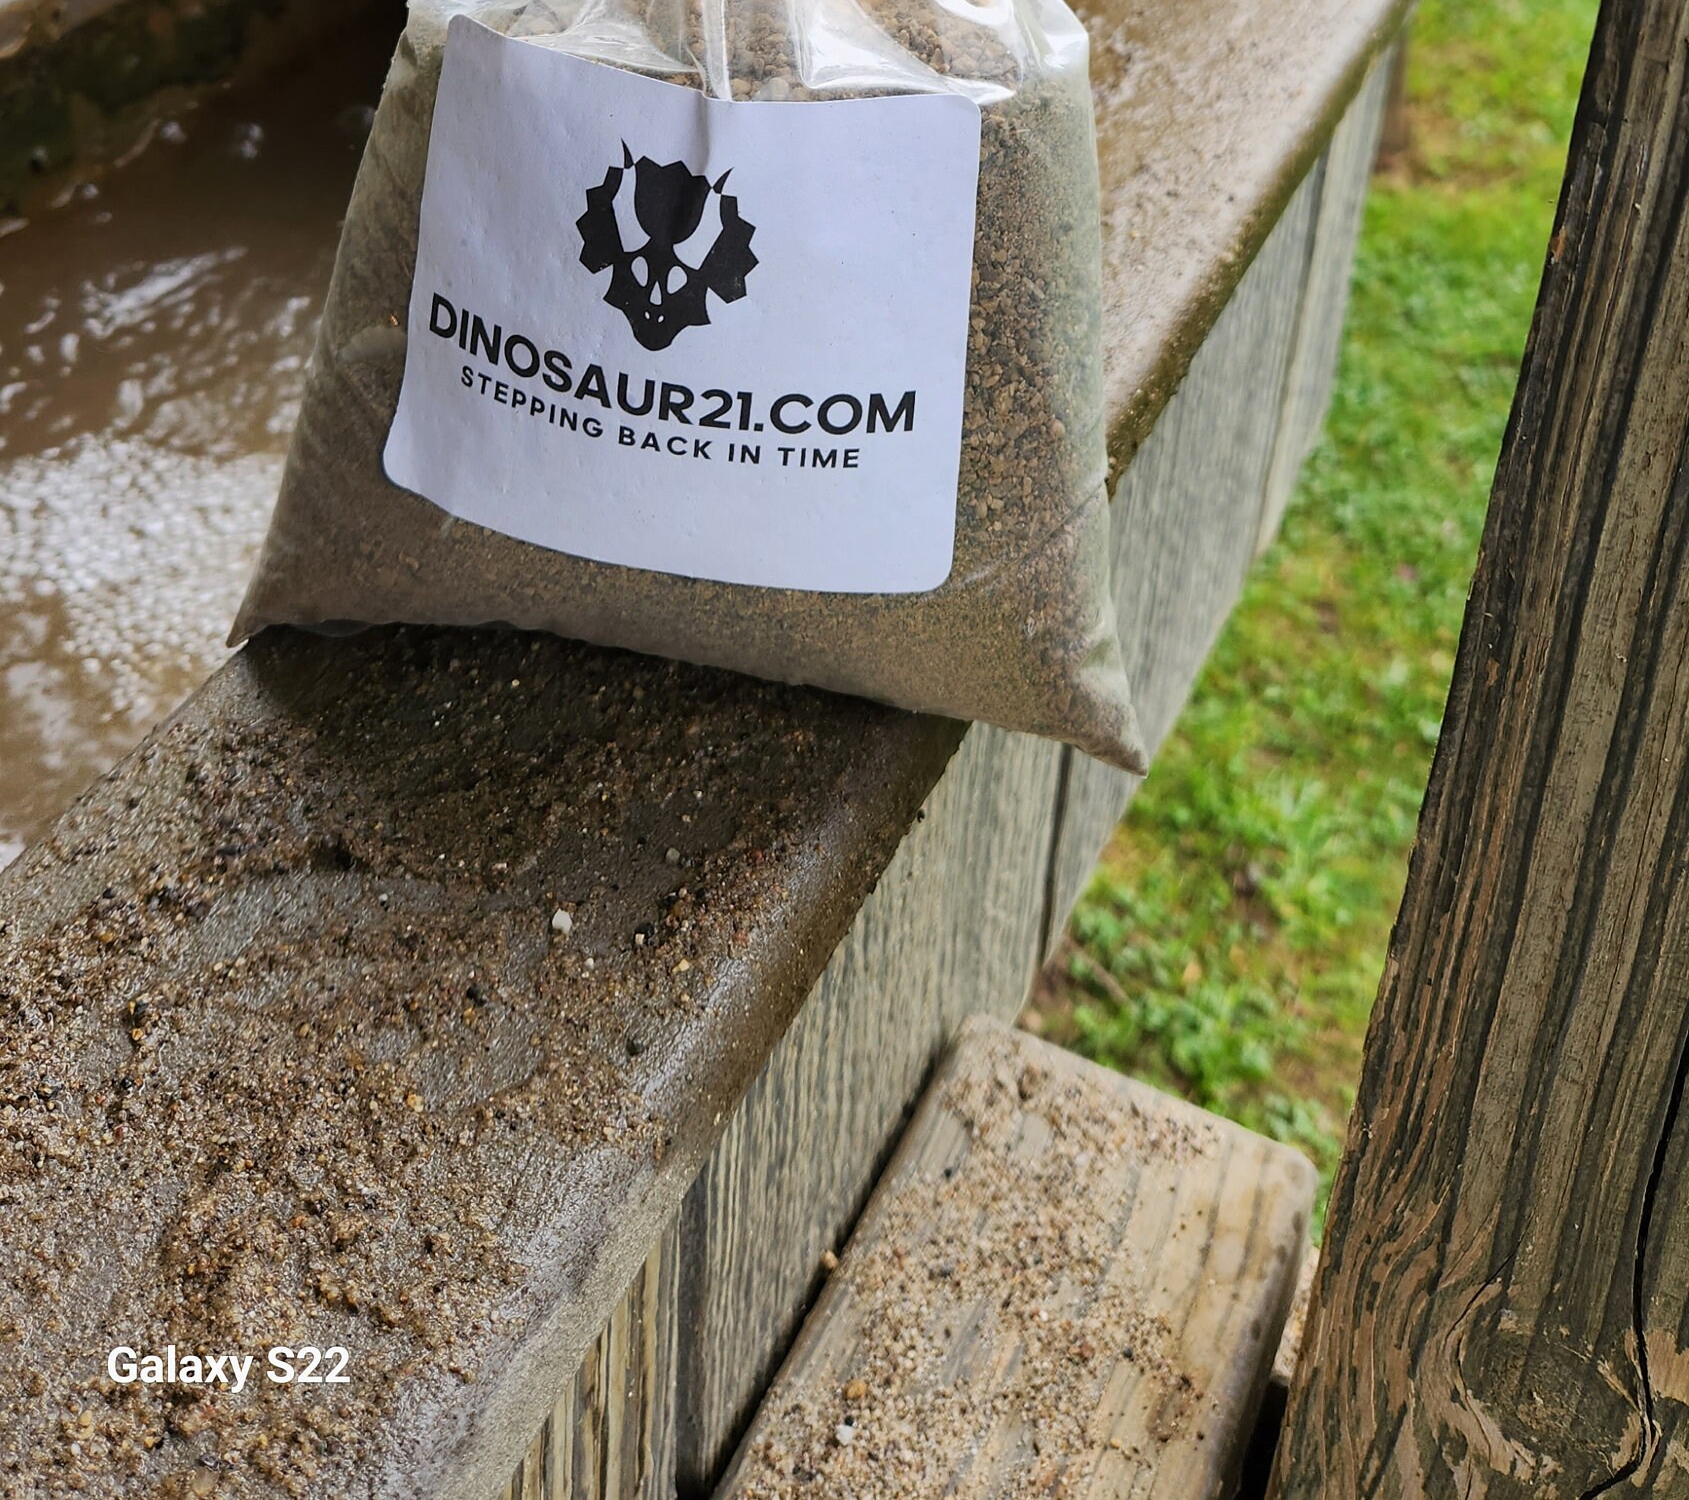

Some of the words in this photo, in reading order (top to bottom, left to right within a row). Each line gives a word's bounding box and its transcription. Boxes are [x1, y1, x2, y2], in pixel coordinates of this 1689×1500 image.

[429, 293, 916, 436] DINOSAUR21.COM
[461, 365, 603, 438] STEPPING
[618, 426, 712, 460] BACK
[728, 443, 760, 464] IN
[777, 447, 860, 469] TIME
